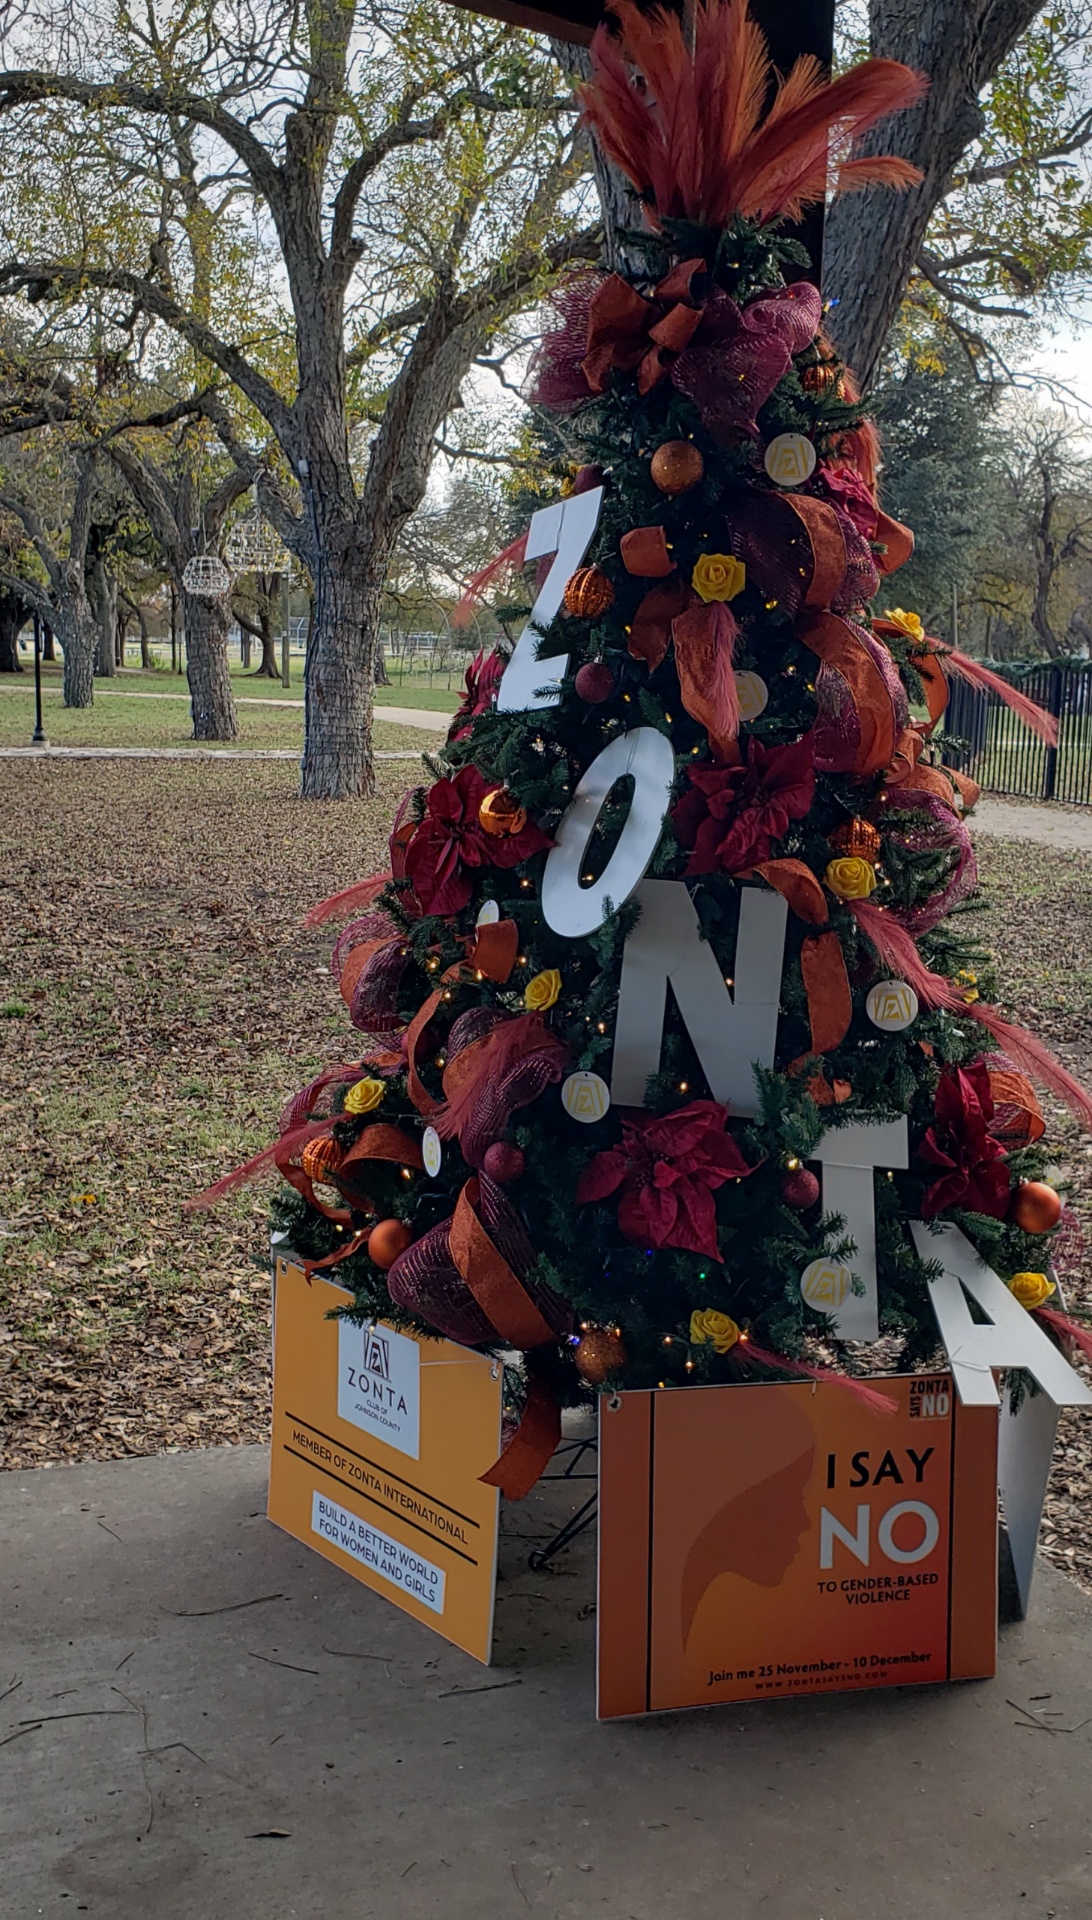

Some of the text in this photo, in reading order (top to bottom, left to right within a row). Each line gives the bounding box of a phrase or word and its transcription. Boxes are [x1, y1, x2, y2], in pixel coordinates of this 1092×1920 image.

[347, 1366, 408, 1416] ZONTA
[910, 1379, 950, 1394] ZONTA
[354, 1403, 401, 1433] JOHNSON COUNTY
[366, 1399, 389, 1415] CLUB OF
[909, 1395, 921, 1417] SAYS
[922, 1393, 949, 1417] NO
[827, 1447, 936, 1489] I SAY
[292, 1429, 469, 1546] MEMBER OF ZONTA INTERNATIONAL
[319, 1500, 439, 1585] BUILD A BETTER WORLD
[819, 1500, 940, 1570] NO
[319, 1518, 436, 1603] FOR WOMEN AND GIRLS
[817, 1573, 939, 1594] TO GENDER-BASED
[845, 1589, 911, 1605] VIOLENCE
[707, 1670, 734, 1686] Join
[736, 1670, 755, 1680] me
[758, 1665, 773, 1677] 25
[777, 1659, 842, 1676] November
[852, 1656, 867, 1668] 10
[870, 1651, 932, 1667] December
[755, 1671, 888, 1690] WWWZONTASAYSNOCOM
